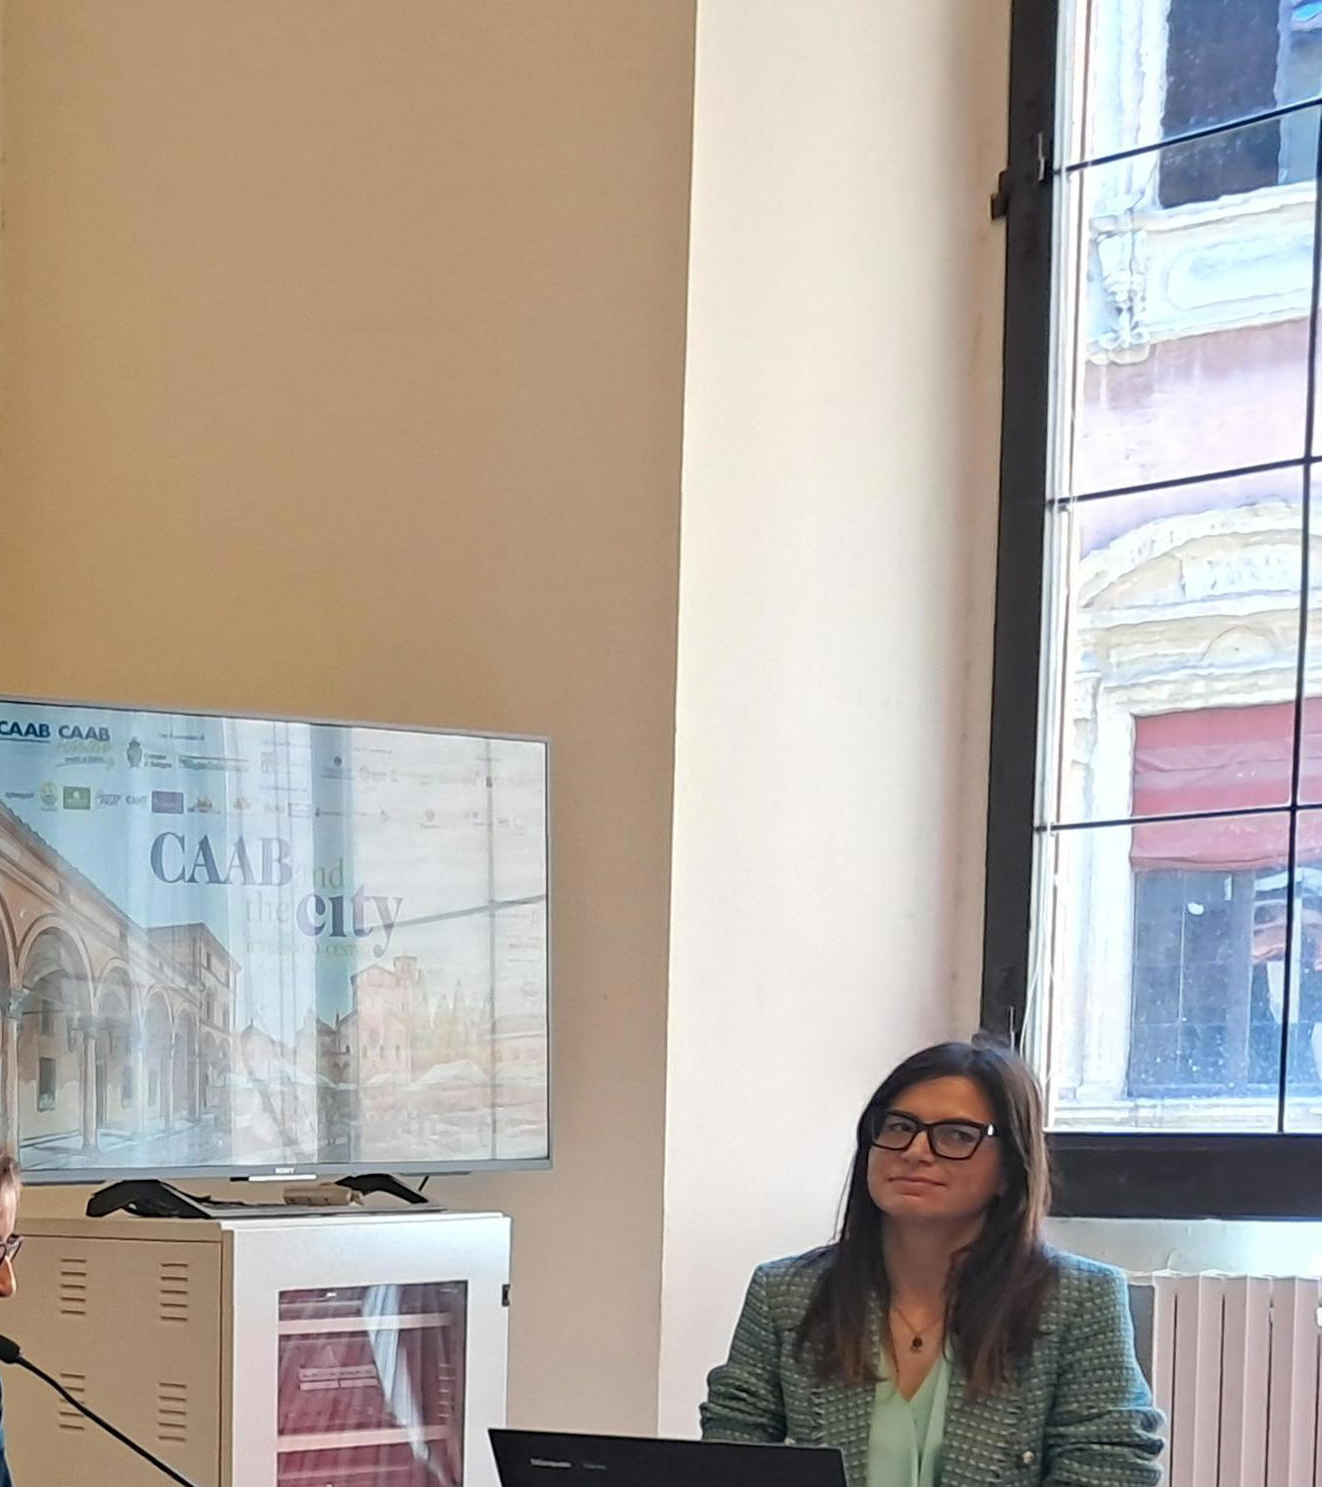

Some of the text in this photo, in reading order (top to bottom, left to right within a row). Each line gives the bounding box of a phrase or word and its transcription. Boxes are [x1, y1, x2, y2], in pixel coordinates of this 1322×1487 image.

[58, 725, 111, 742] CAAB
[150, 831, 293, 887] CAAB
[295, 883, 404, 958] city
